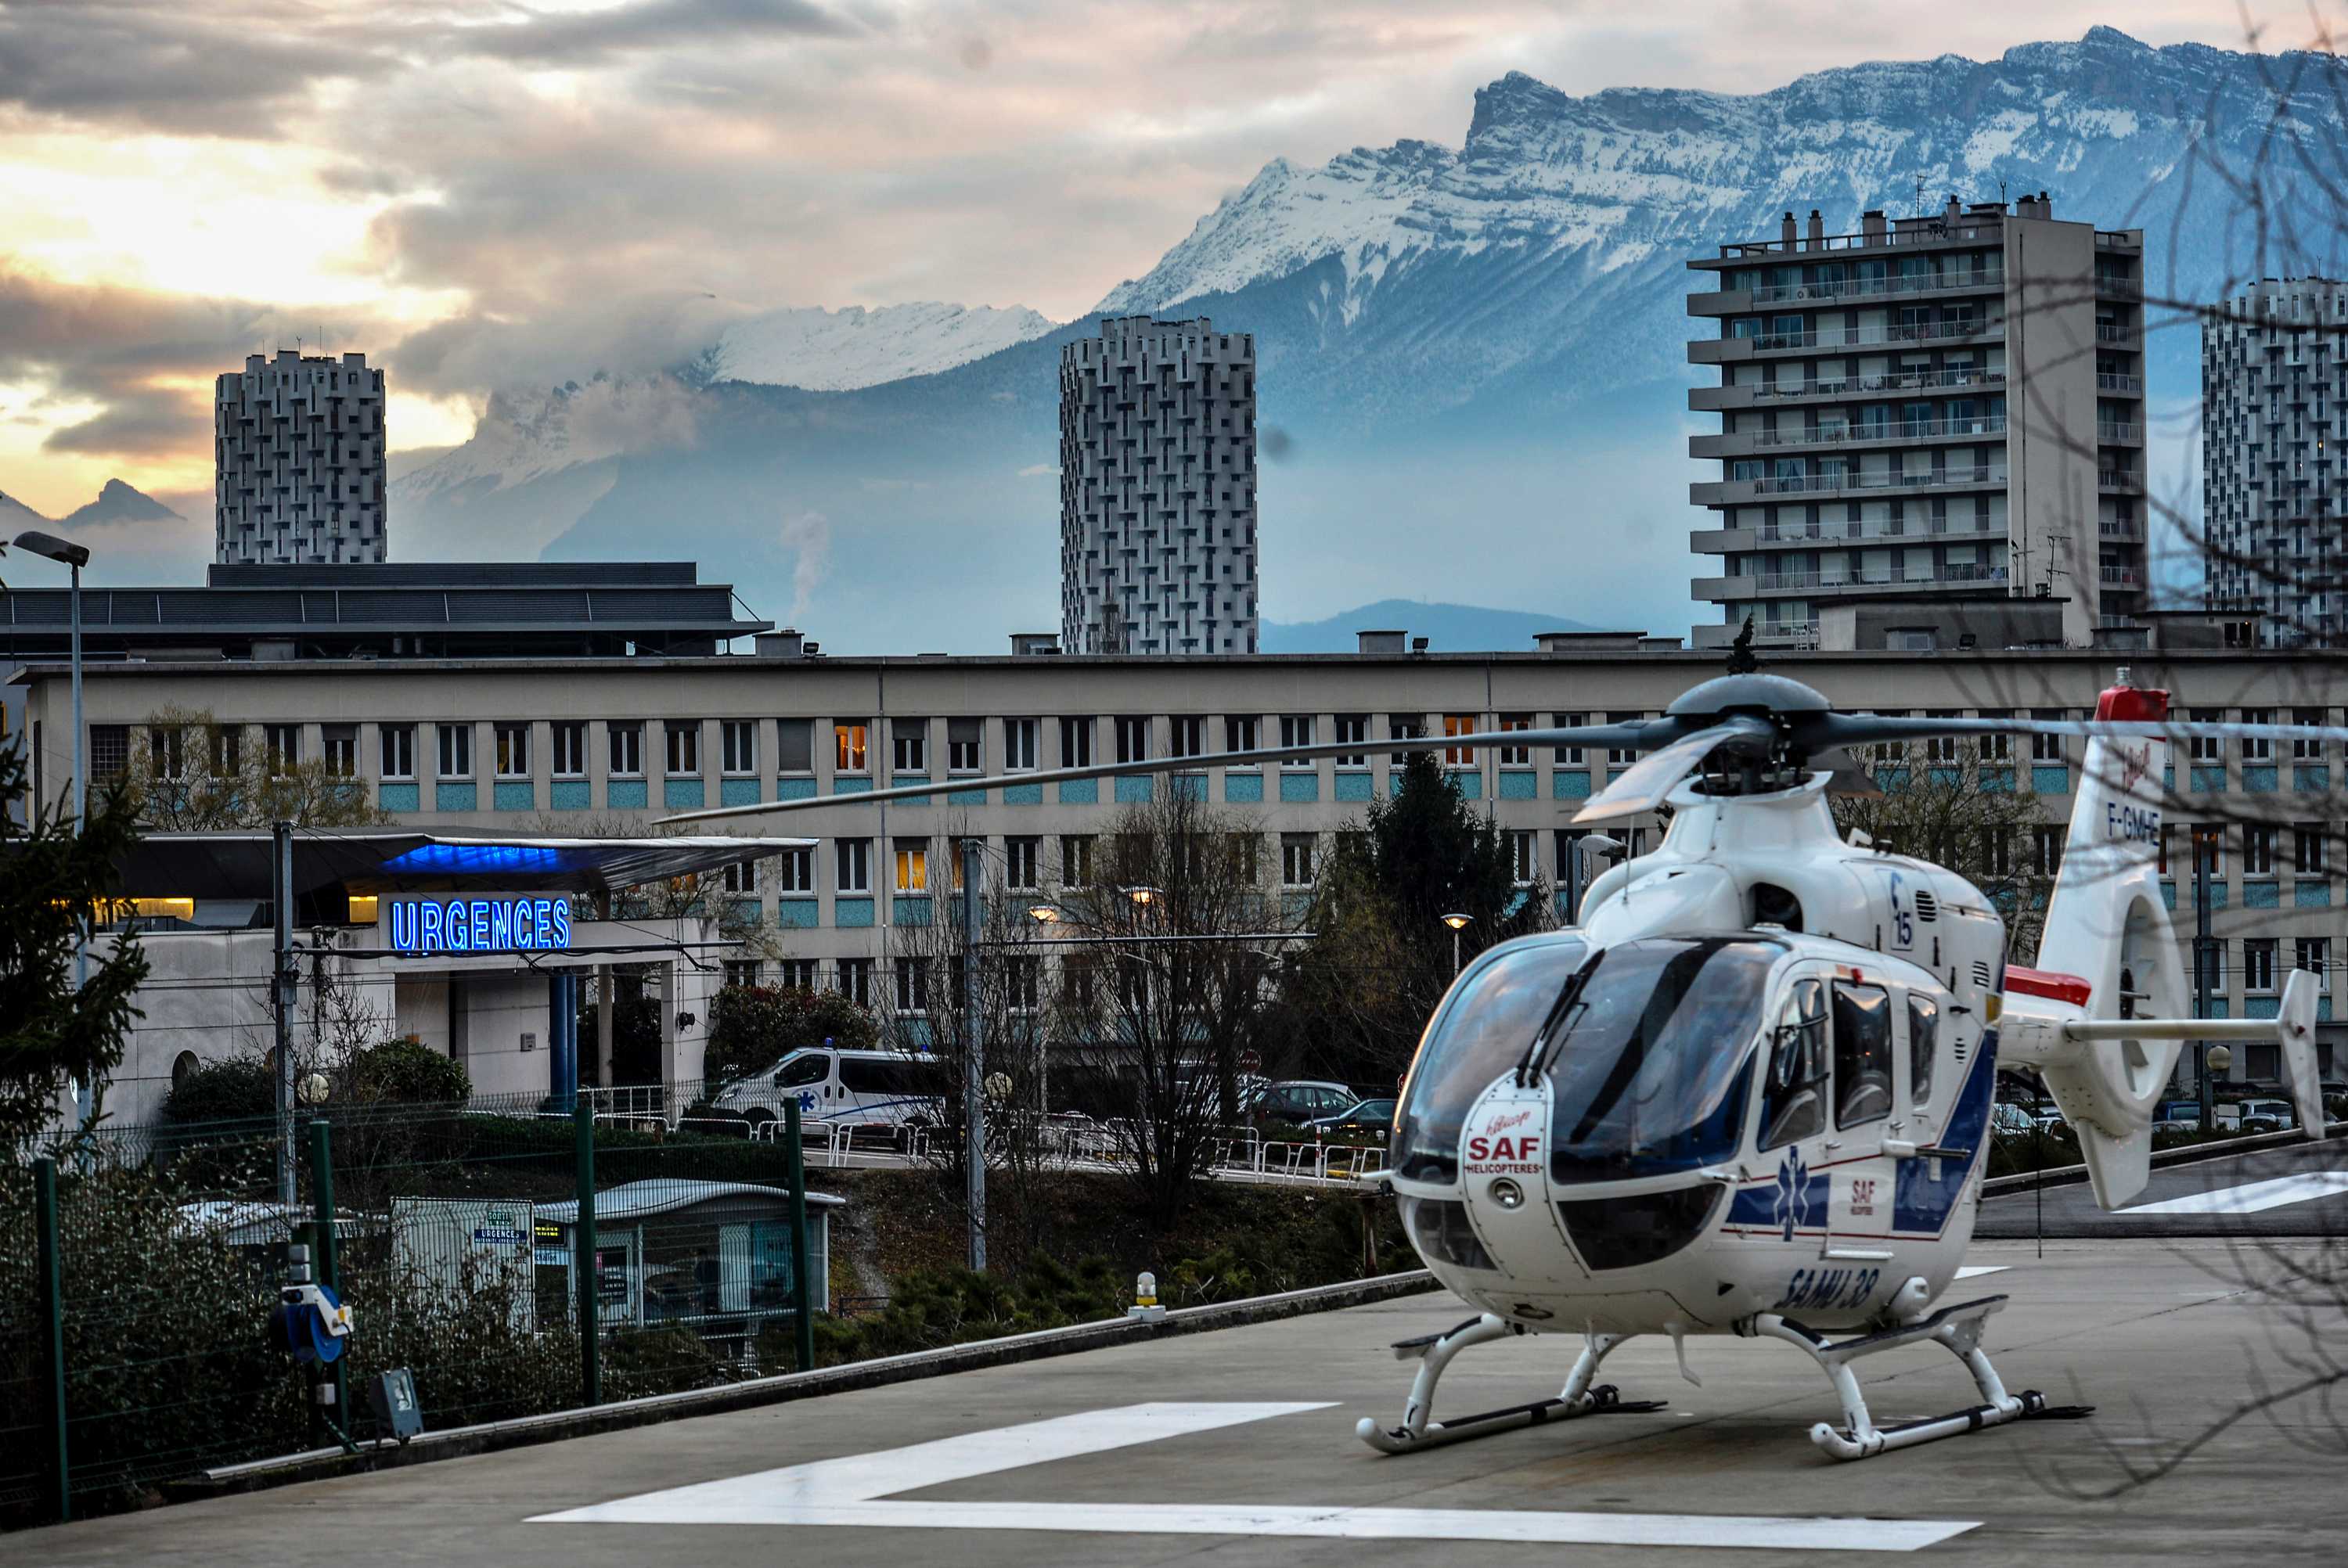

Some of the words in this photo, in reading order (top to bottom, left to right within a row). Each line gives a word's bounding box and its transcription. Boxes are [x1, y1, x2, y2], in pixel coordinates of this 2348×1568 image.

[391, 899, 571, 951] URGENCES
[1895, 911, 1912, 945] 15
[1468, 1137, 1540, 1160] SAF
[1467, 1163, 1540, 1174] HELICOPTERES
[1853, 1180, 1875, 1203] SAF
[481, 1229, 520, 1239] URGENCES
[1837, 1268, 1879, 1309] 38
